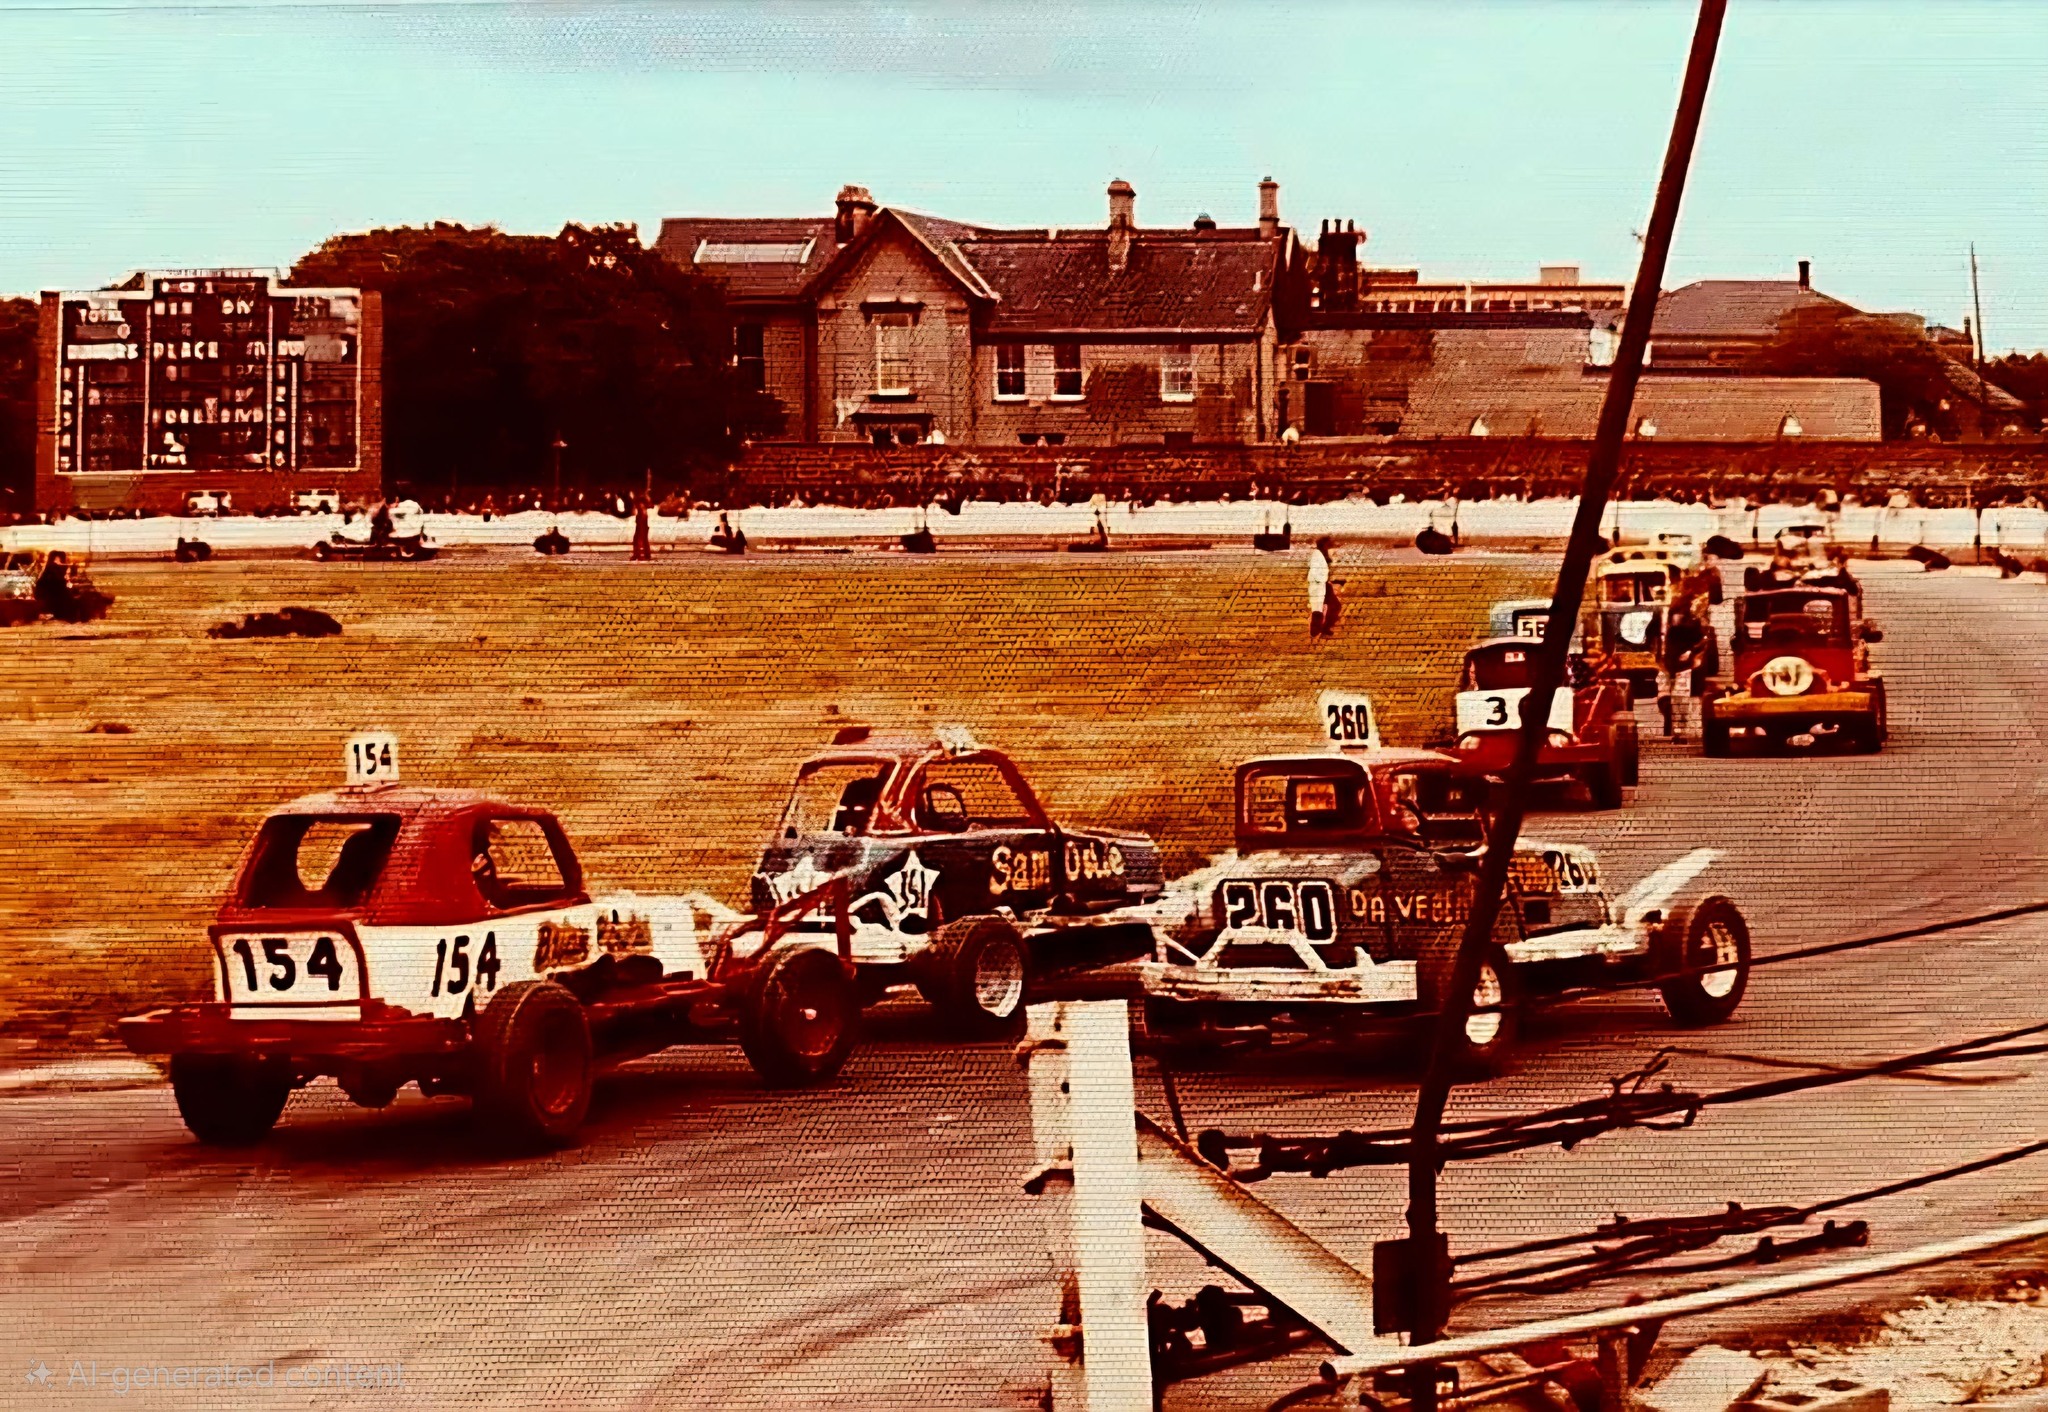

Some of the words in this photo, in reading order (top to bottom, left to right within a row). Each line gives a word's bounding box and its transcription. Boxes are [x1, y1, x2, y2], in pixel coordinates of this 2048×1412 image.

[1328, 703, 1370, 742] 260
[1485, 696, 1508, 726] 3
[352, 741, 393, 776] 154
[989, 845, 1050, 895] Sam
[1222, 880, 1338, 945] 260
[232, 935, 344, 993] 154
[431, 930, 501, 998] 154
